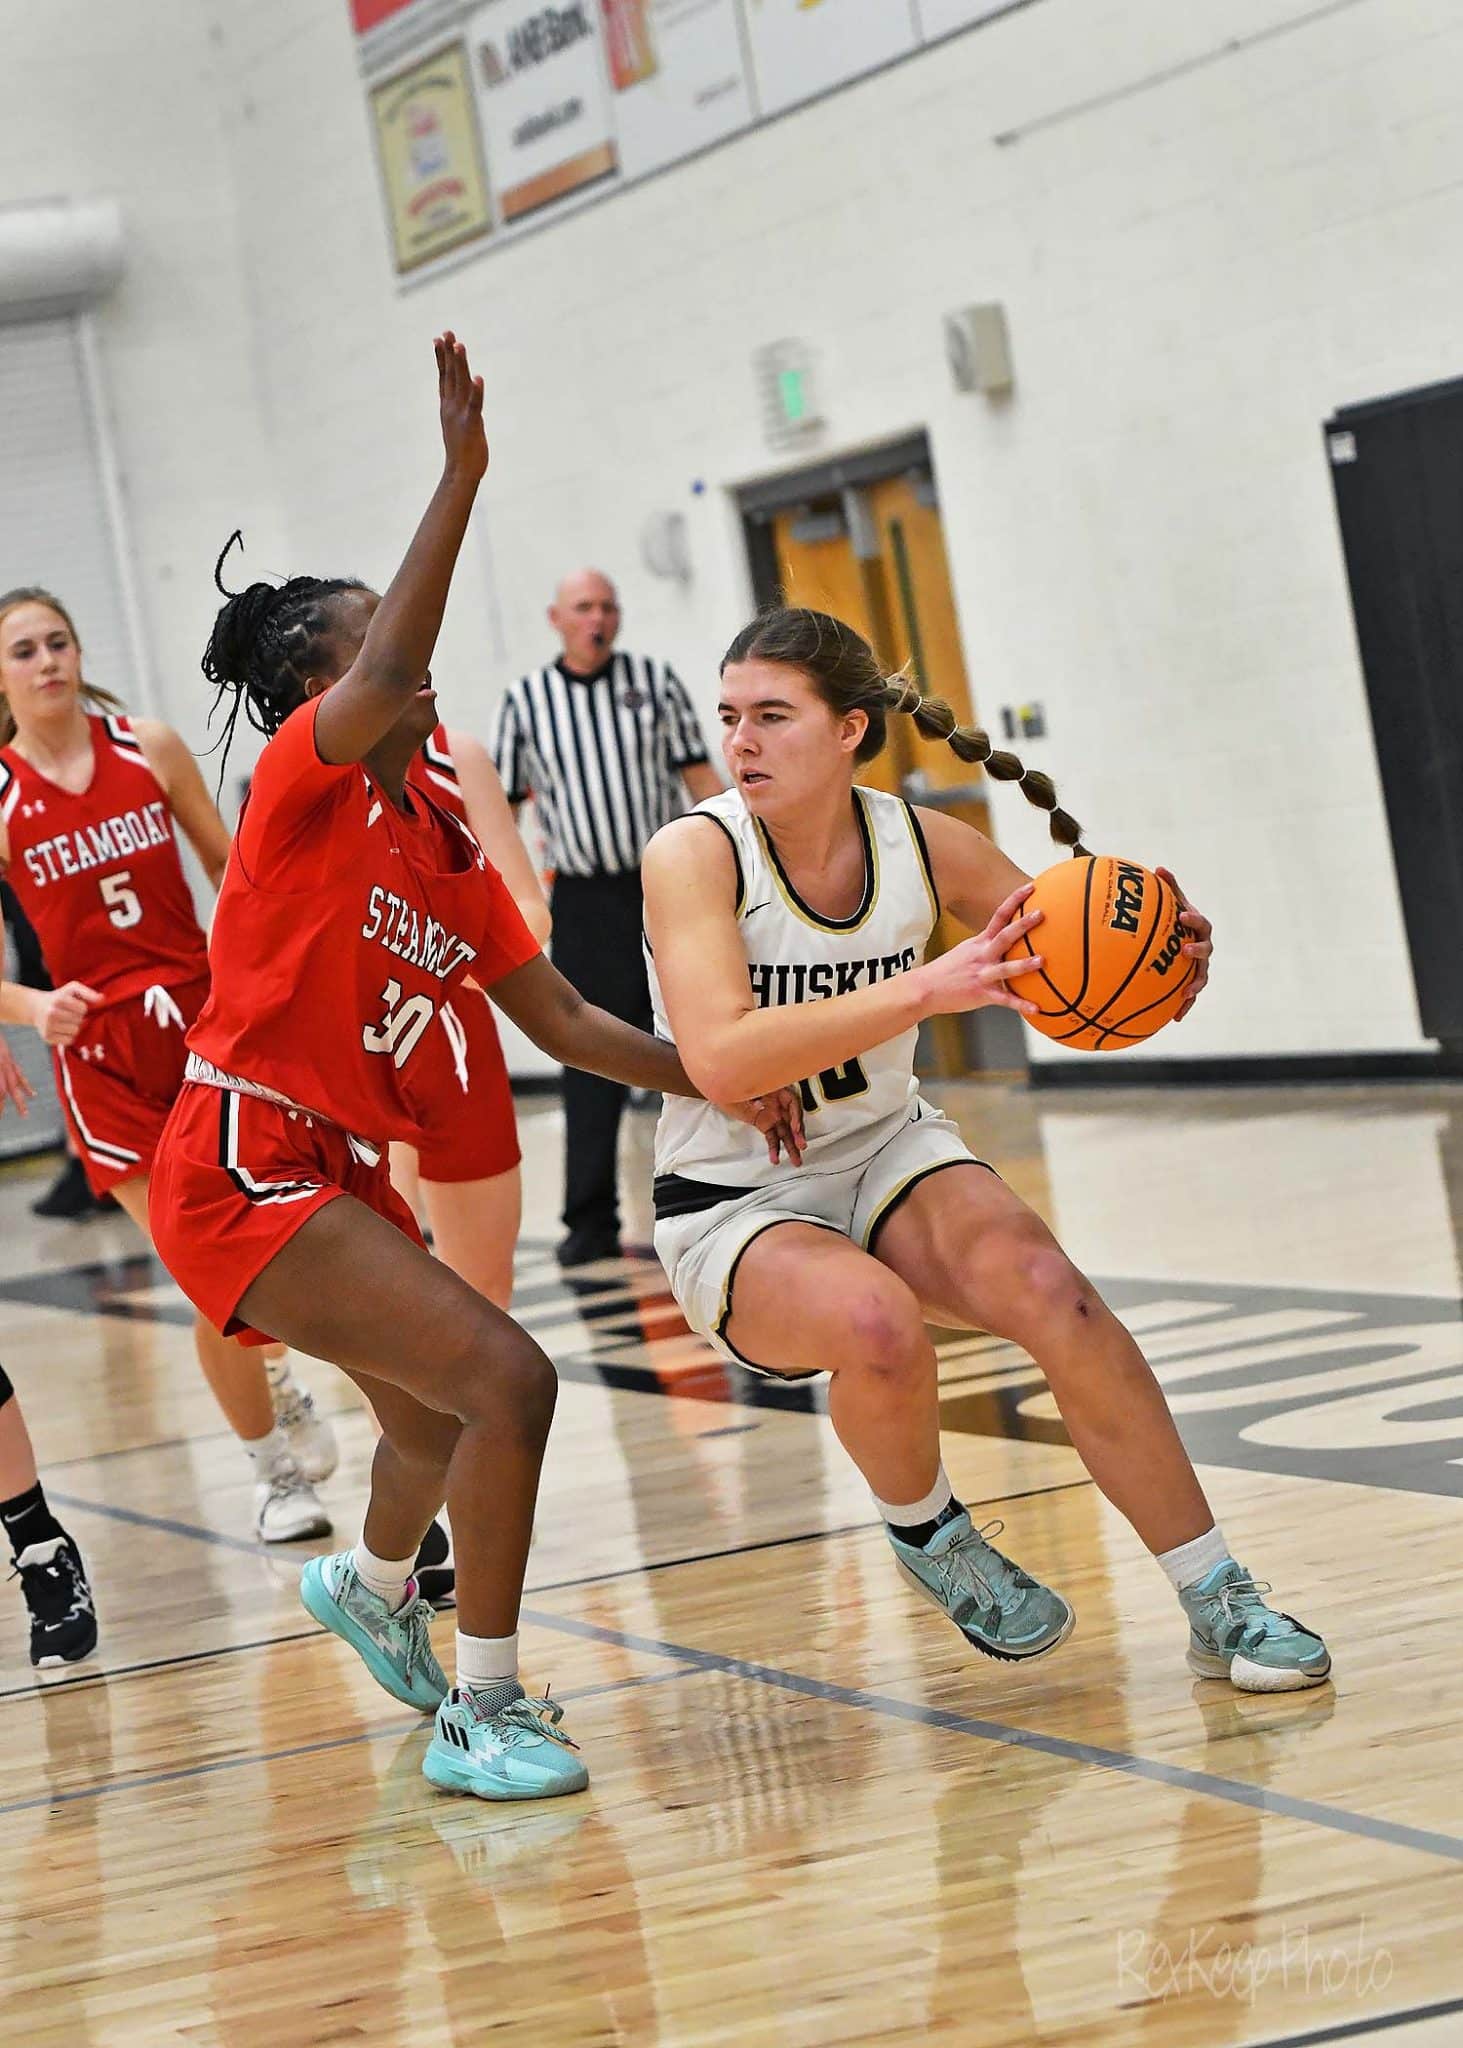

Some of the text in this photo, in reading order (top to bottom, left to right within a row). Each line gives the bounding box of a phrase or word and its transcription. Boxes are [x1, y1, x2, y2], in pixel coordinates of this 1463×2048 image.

[23, 801, 171, 888] STEAMBOAT
[99, 869, 144, 930] 5
[1110, 860, 1144, 933] NCAA
[362, 977, 435, 1070] 30
